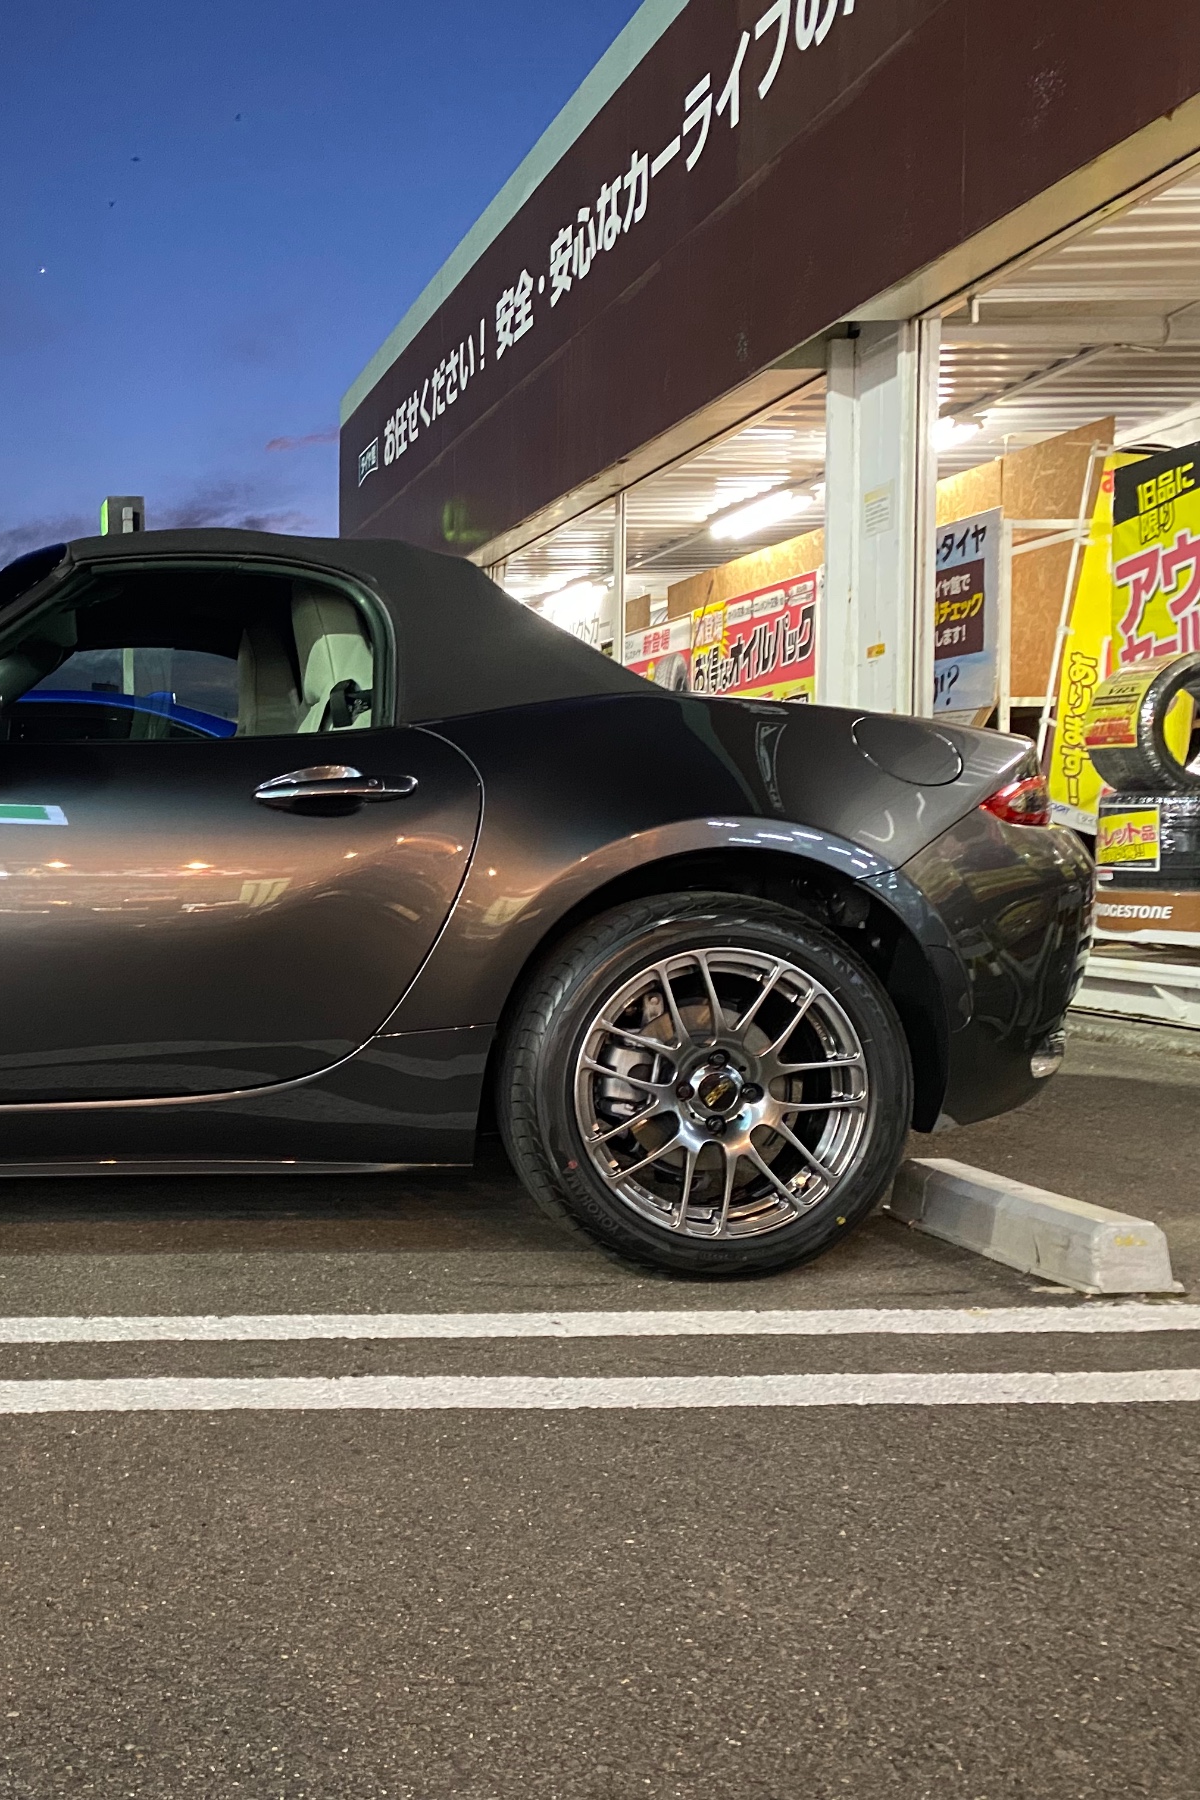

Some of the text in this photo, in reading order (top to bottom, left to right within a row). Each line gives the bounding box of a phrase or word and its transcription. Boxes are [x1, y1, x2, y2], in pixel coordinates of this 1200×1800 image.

[496, 0, 854, 360] 安全・安心なカーライフの
[936, 524, 988, 566] タイヤ
